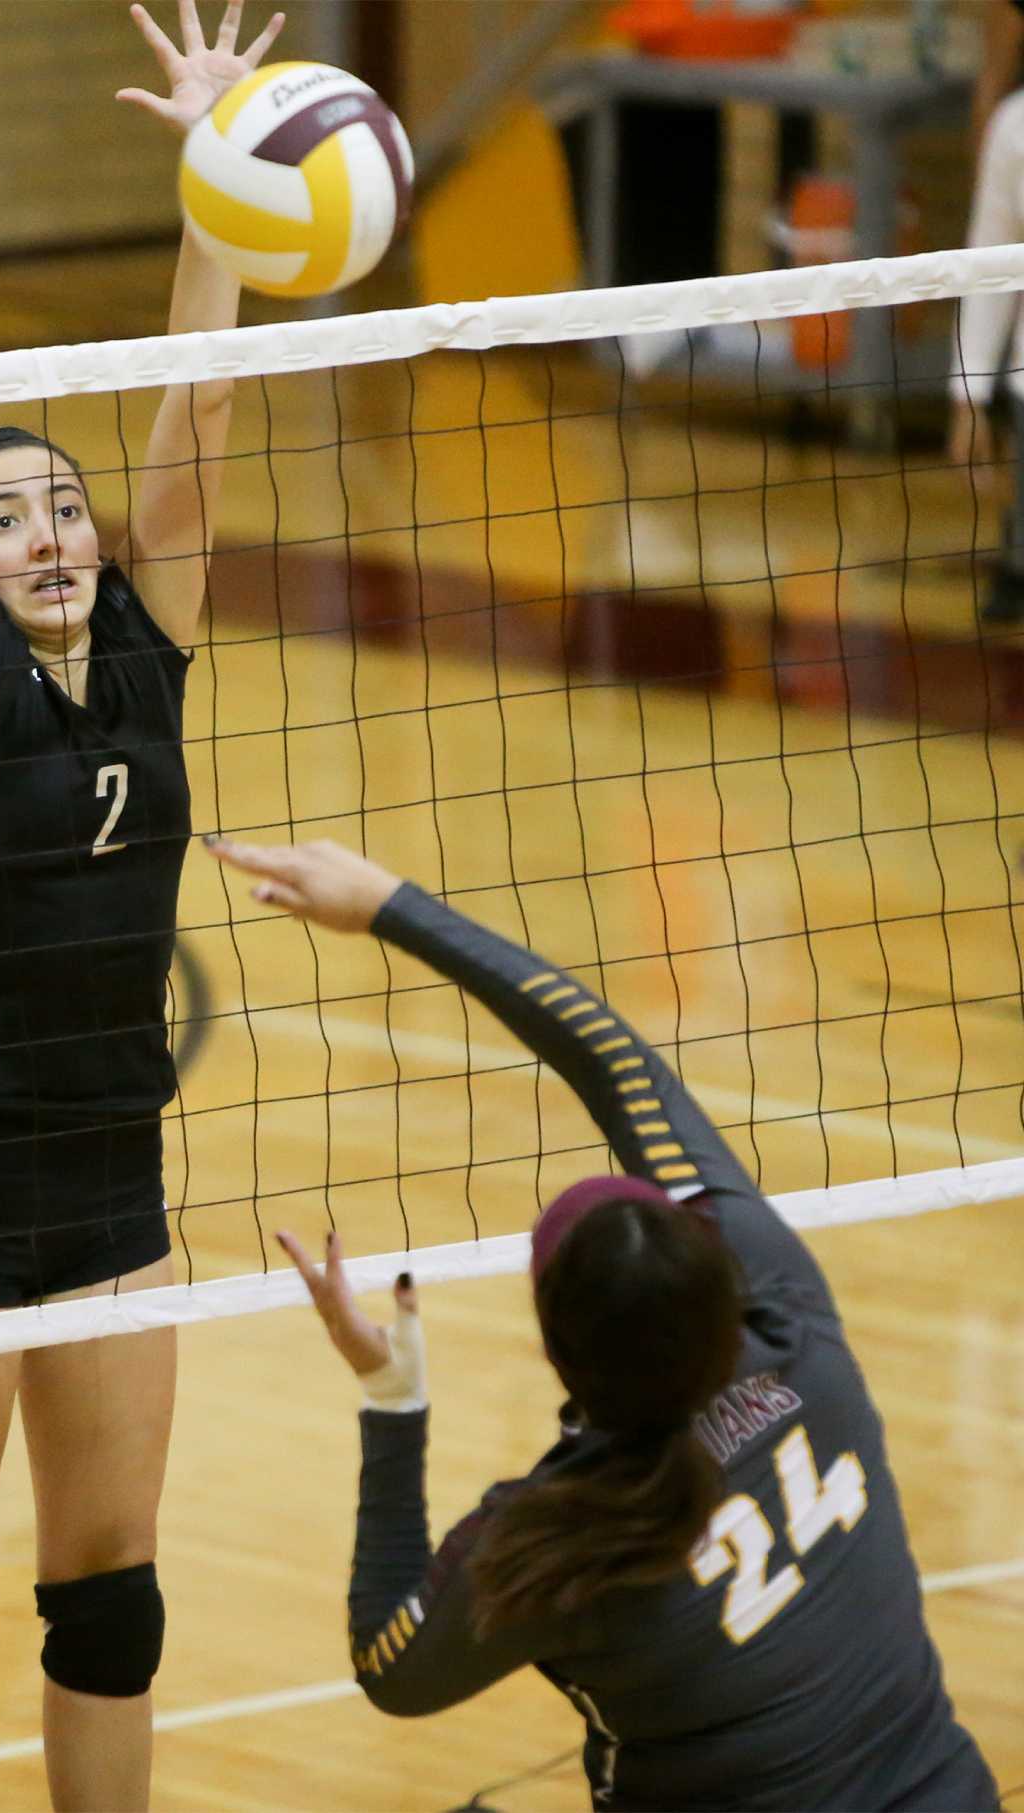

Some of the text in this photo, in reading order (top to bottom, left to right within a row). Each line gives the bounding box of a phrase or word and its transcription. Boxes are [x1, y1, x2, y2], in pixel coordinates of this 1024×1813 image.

[92, 763, 128, 856] 2
[692, 1374, 803, 1464] IANS
[688, 1424, 869, 1646] 24
